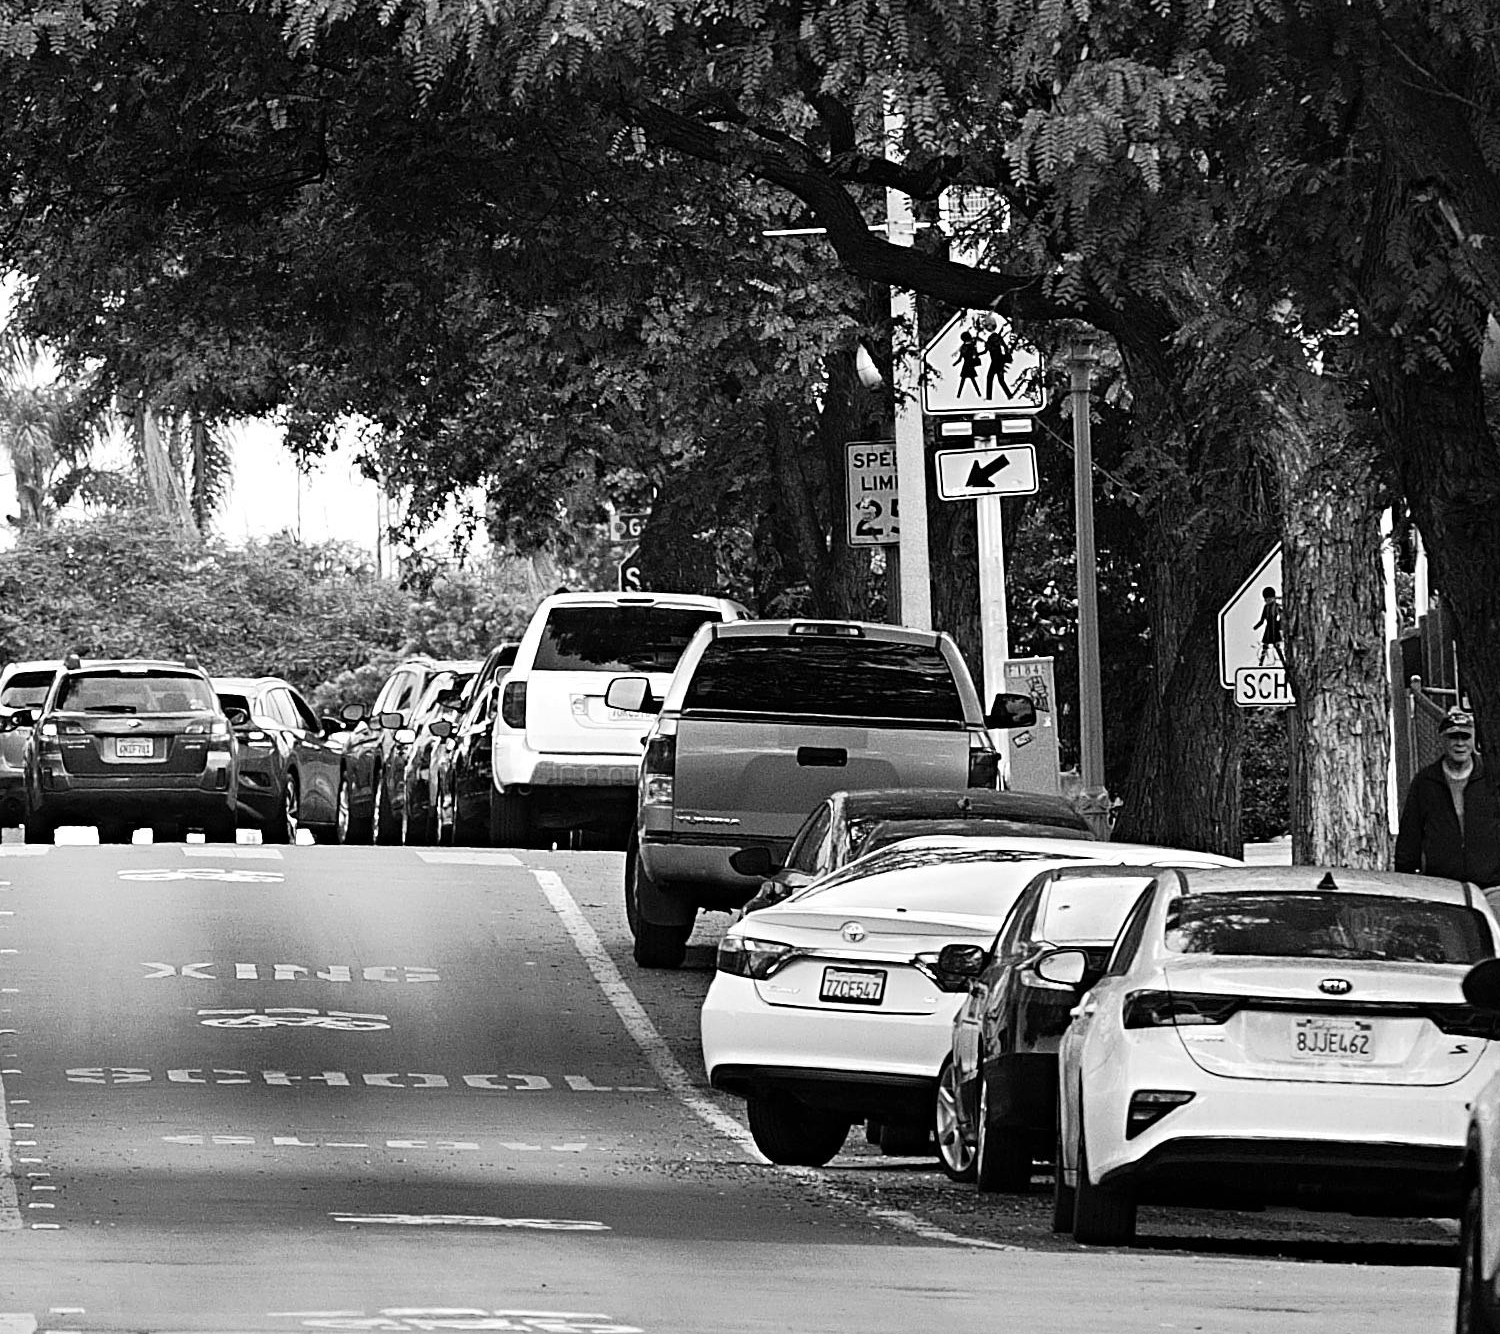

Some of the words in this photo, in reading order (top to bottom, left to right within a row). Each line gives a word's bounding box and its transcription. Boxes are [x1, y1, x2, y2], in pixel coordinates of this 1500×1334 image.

[140, 962, 442, 983] XING
[826, 979, 881, 1000] 7ZCE547
[1297, 1032, 1370, 1055] 8JJE462
[64, 1067, 660, 1093] SCHOOL
